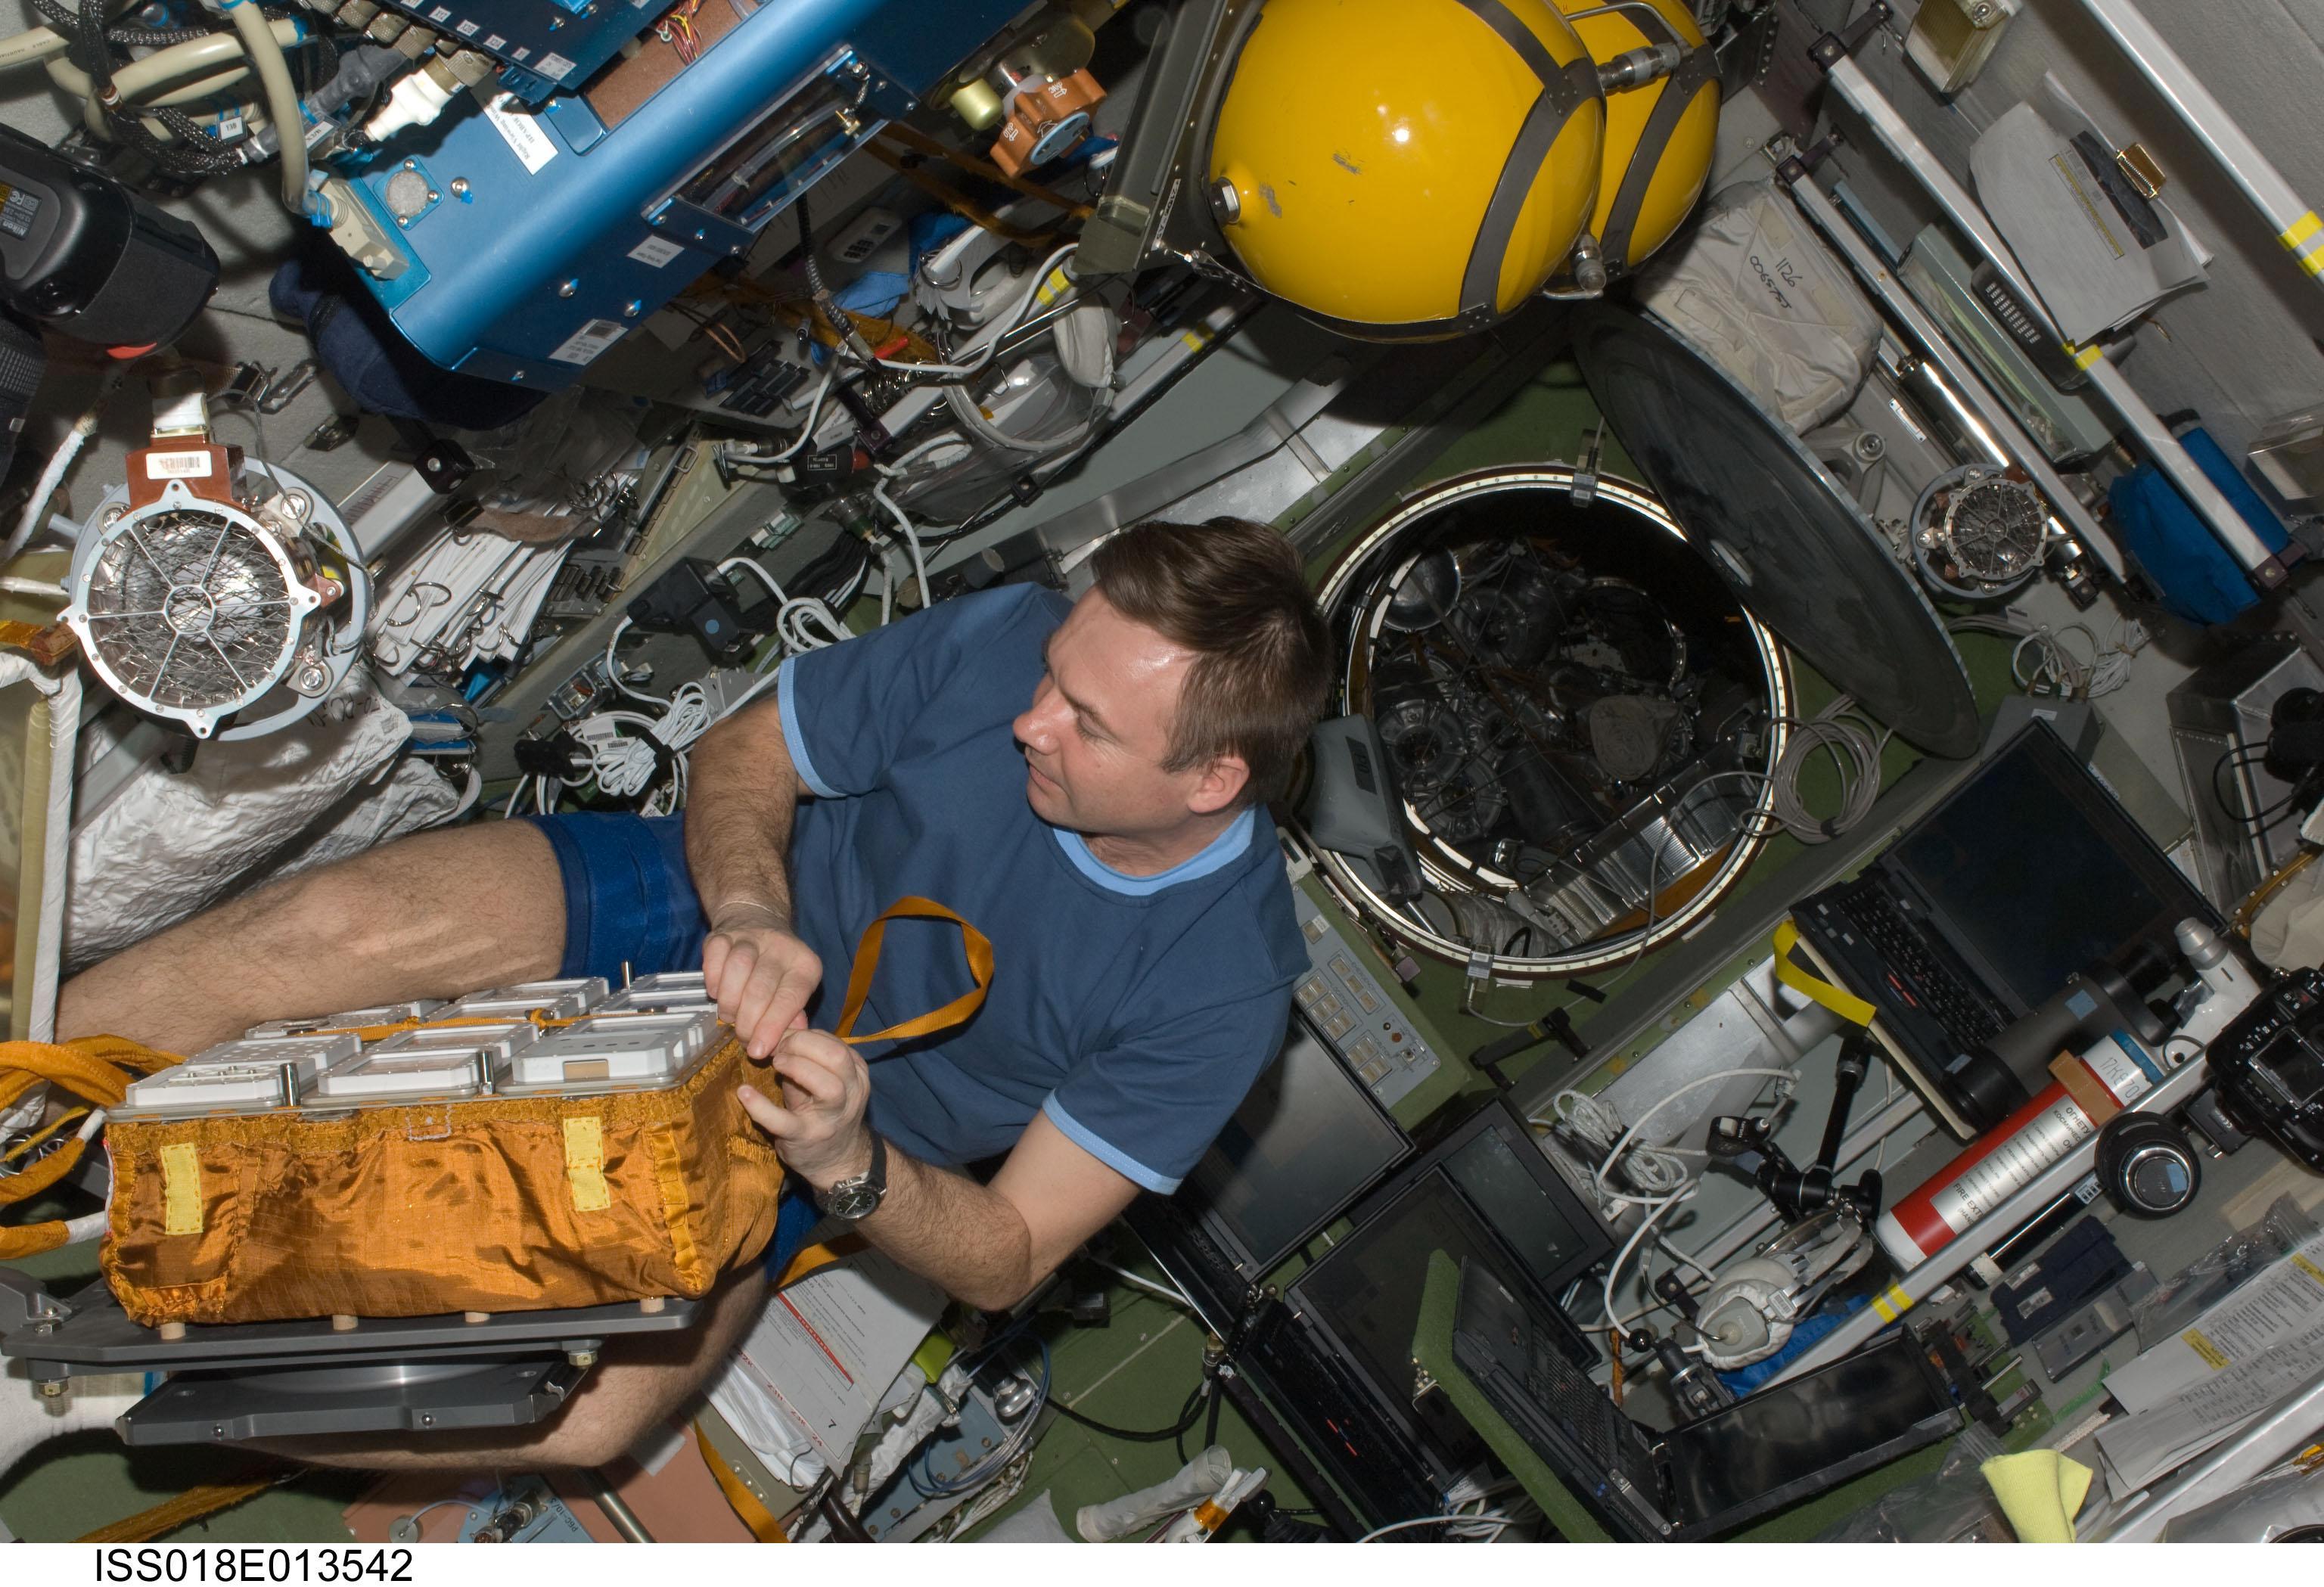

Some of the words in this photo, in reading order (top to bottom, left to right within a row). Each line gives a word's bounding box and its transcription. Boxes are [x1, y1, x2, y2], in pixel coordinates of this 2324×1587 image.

[2, 220, 27, 236] Nikon
[1776, 257, 1803, 287] 1126
[1953, 1183, 1969, 1201] FIRE
